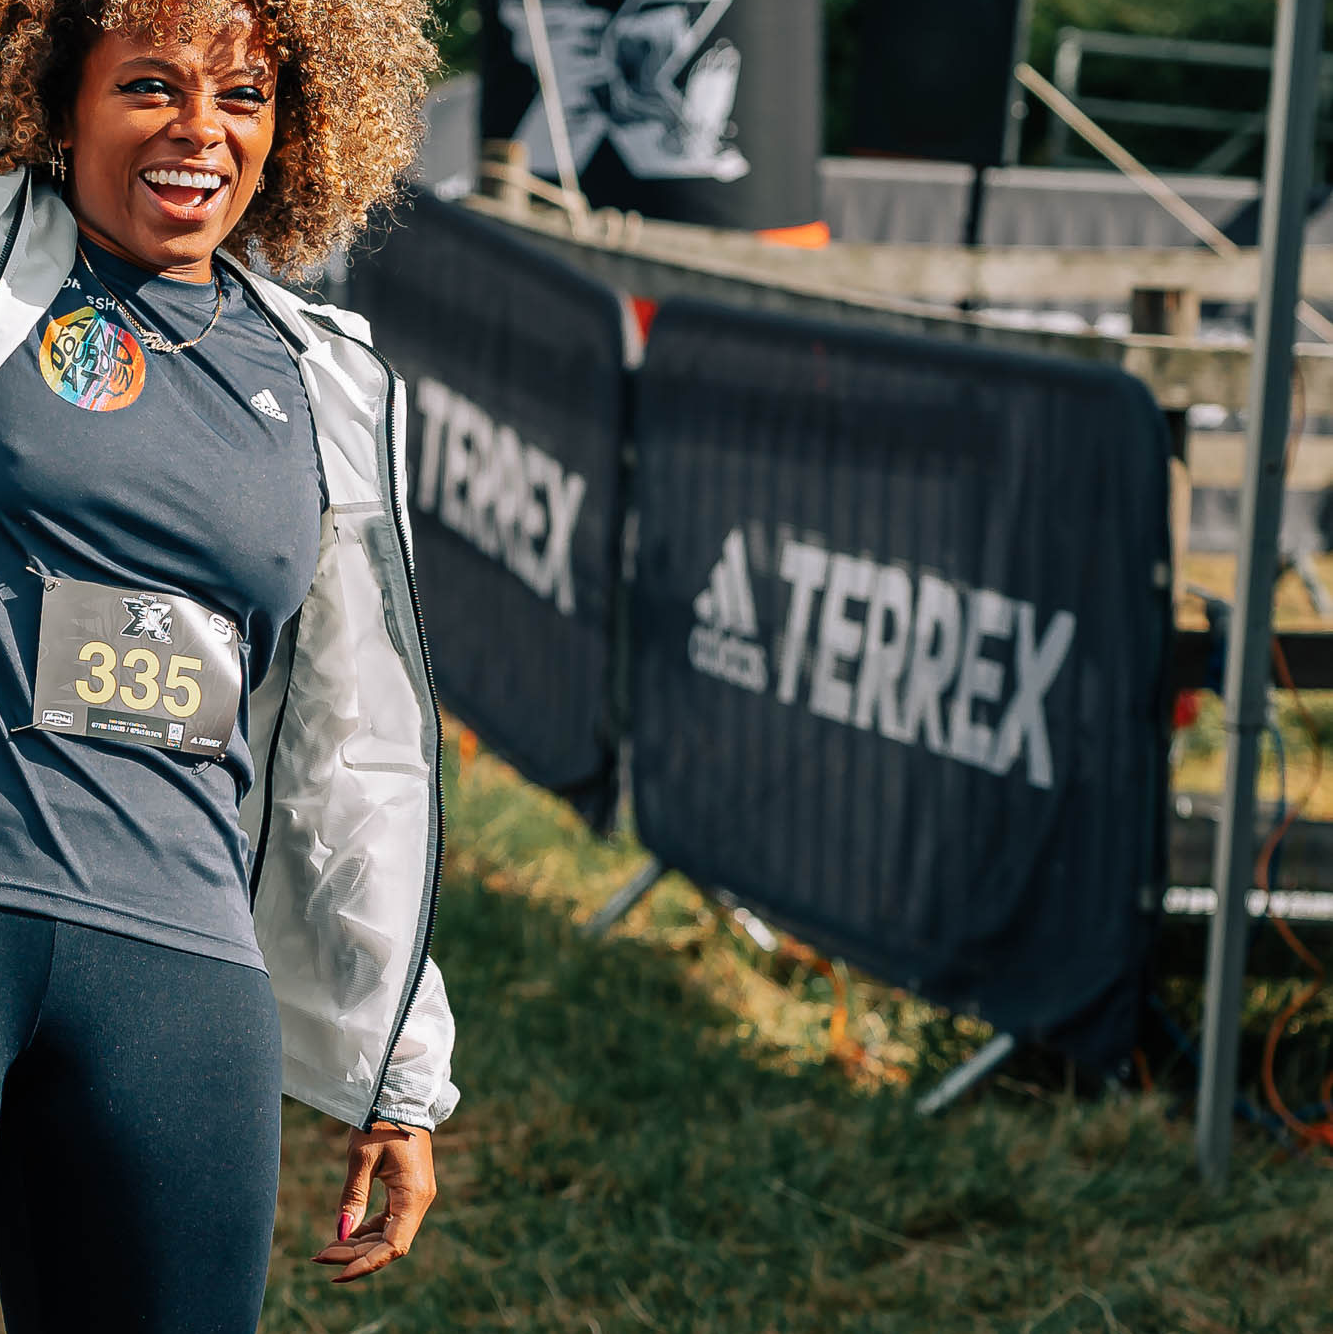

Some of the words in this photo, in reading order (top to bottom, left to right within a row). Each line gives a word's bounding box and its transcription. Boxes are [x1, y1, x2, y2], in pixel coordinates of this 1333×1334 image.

[55, 326, 100, 371] YOUR
[415, 376, 586, 616] TERREX
[75, 641, 202, 718] 335
[775, 537, 1077, 790] TERREX
